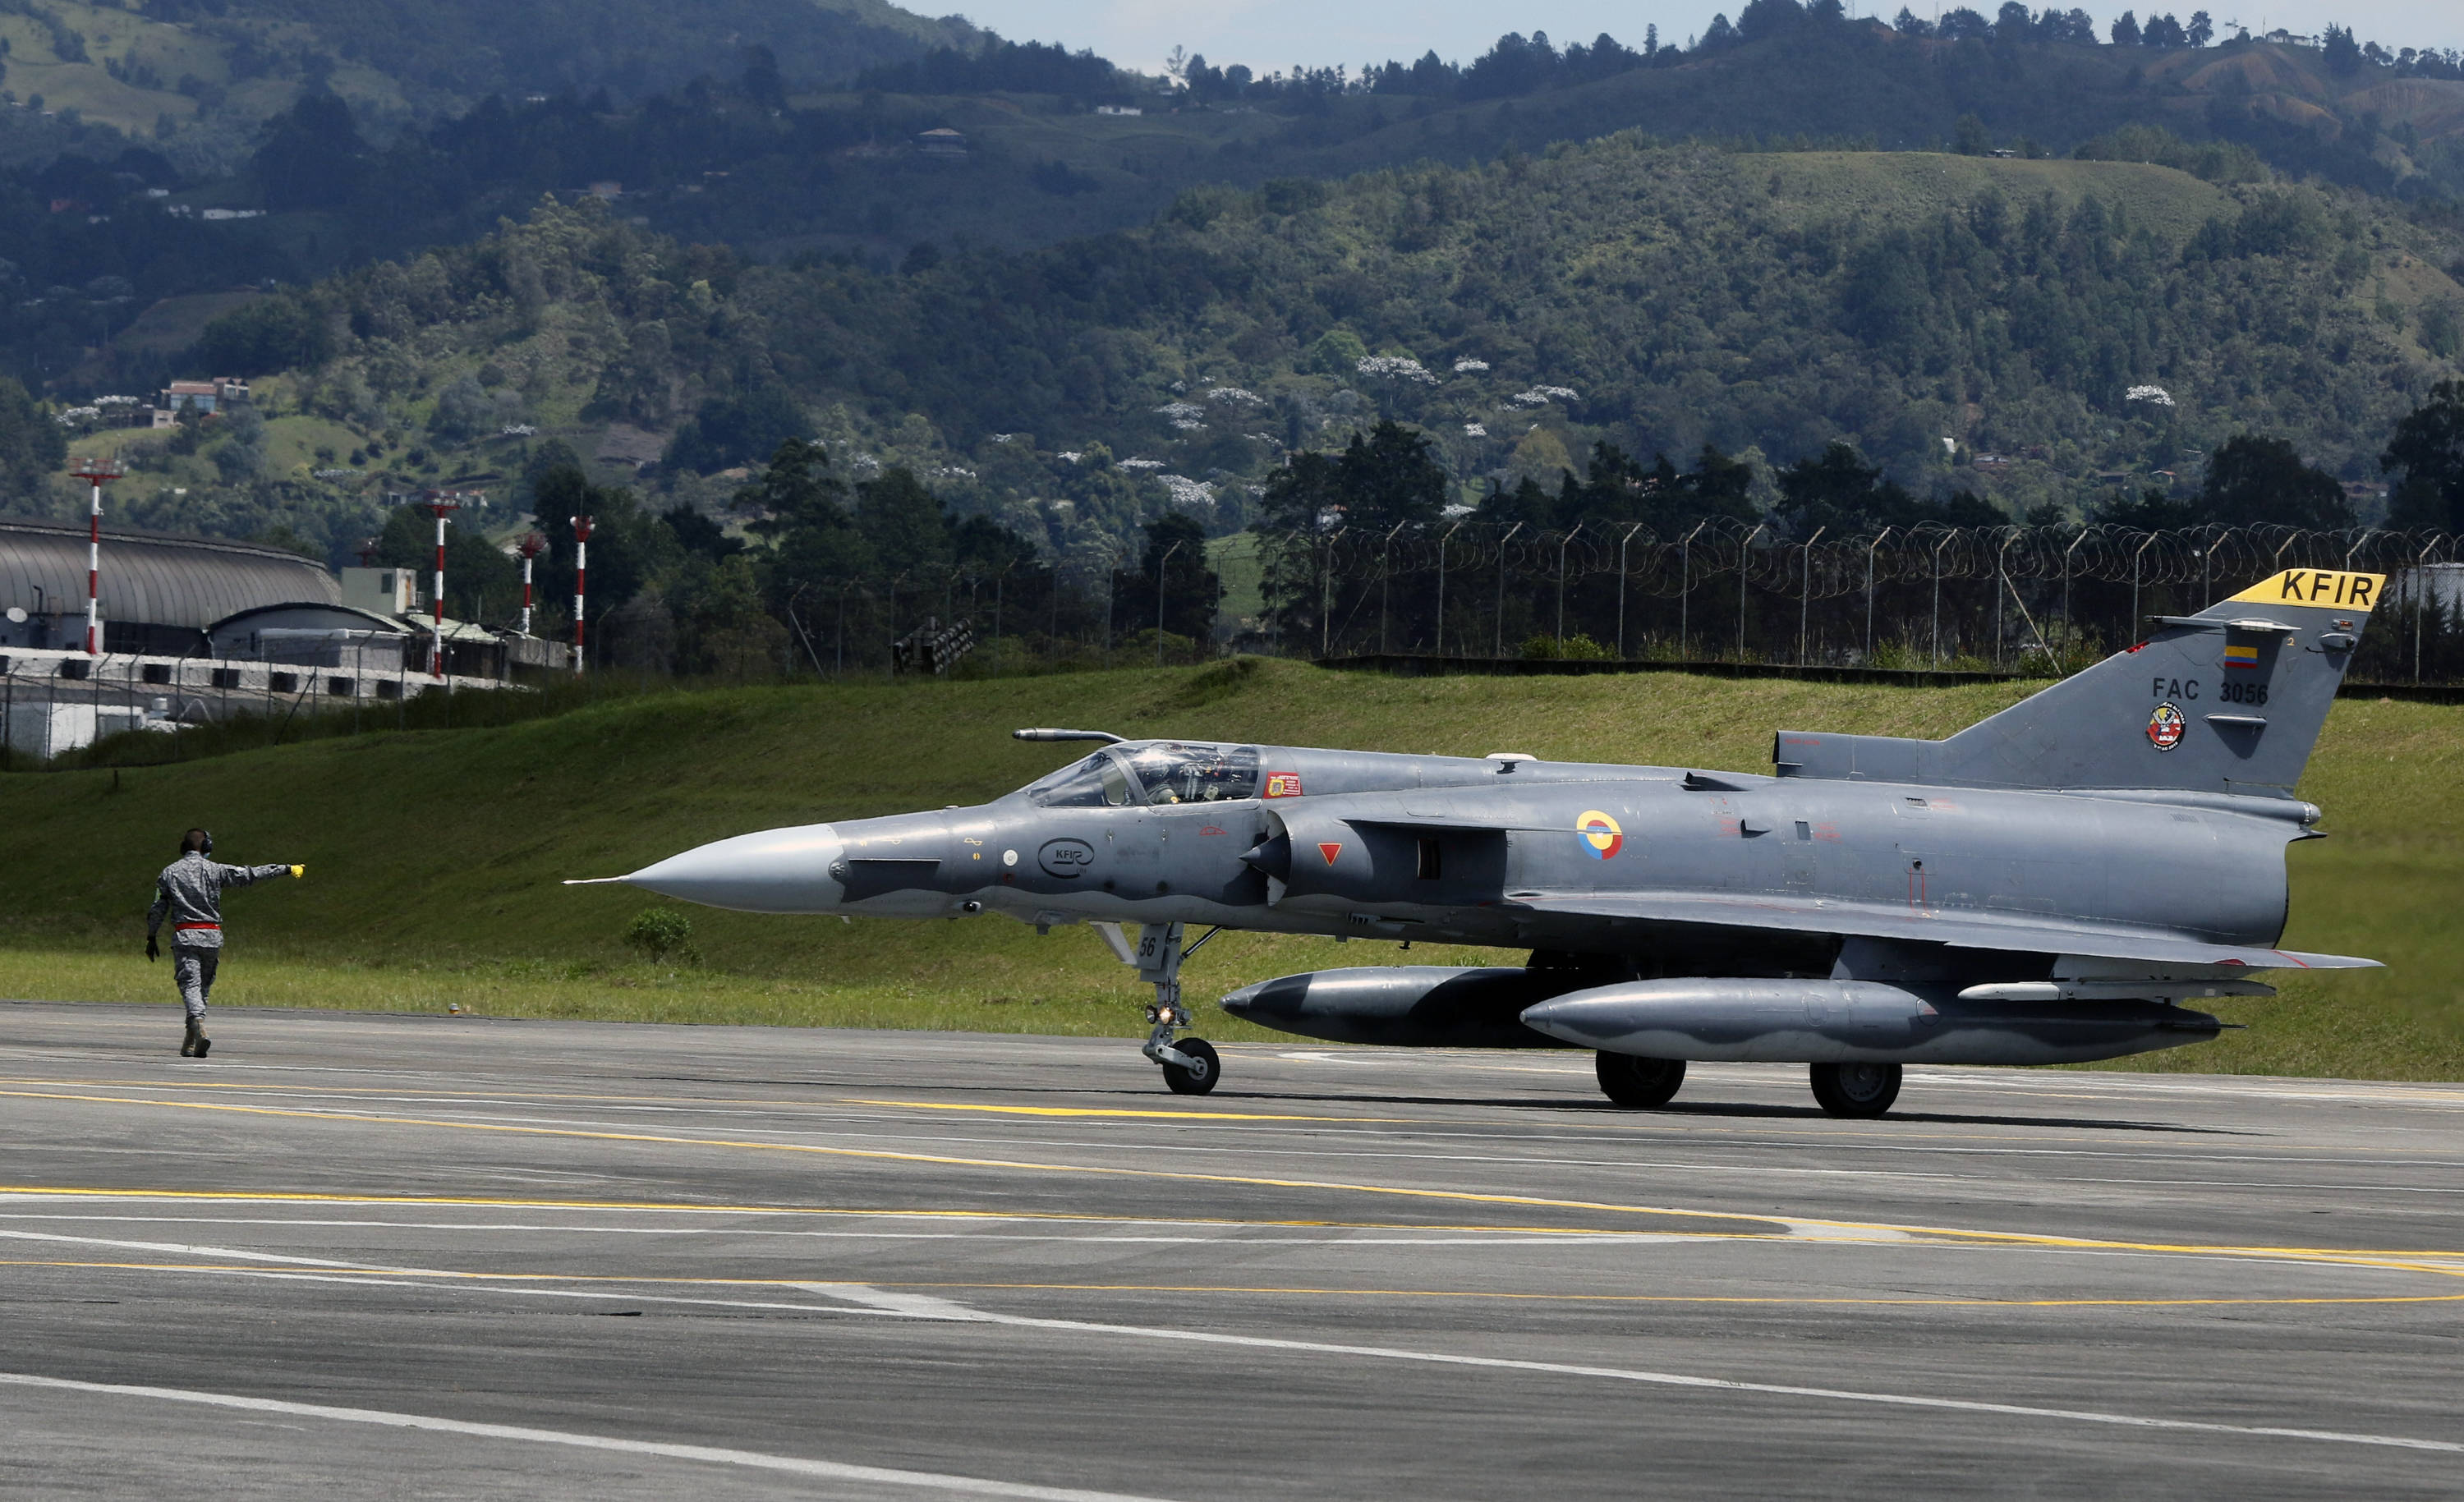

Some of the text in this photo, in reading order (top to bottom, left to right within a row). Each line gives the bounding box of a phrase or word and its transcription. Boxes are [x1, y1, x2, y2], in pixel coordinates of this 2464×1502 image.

[2282, 571, 2373, 606] KFIR
[2153, 678, 2268, 705] FAC 3056
[1055, 849, 1083, 861] KFIR
[1139, 937, 1156, 957] 56
